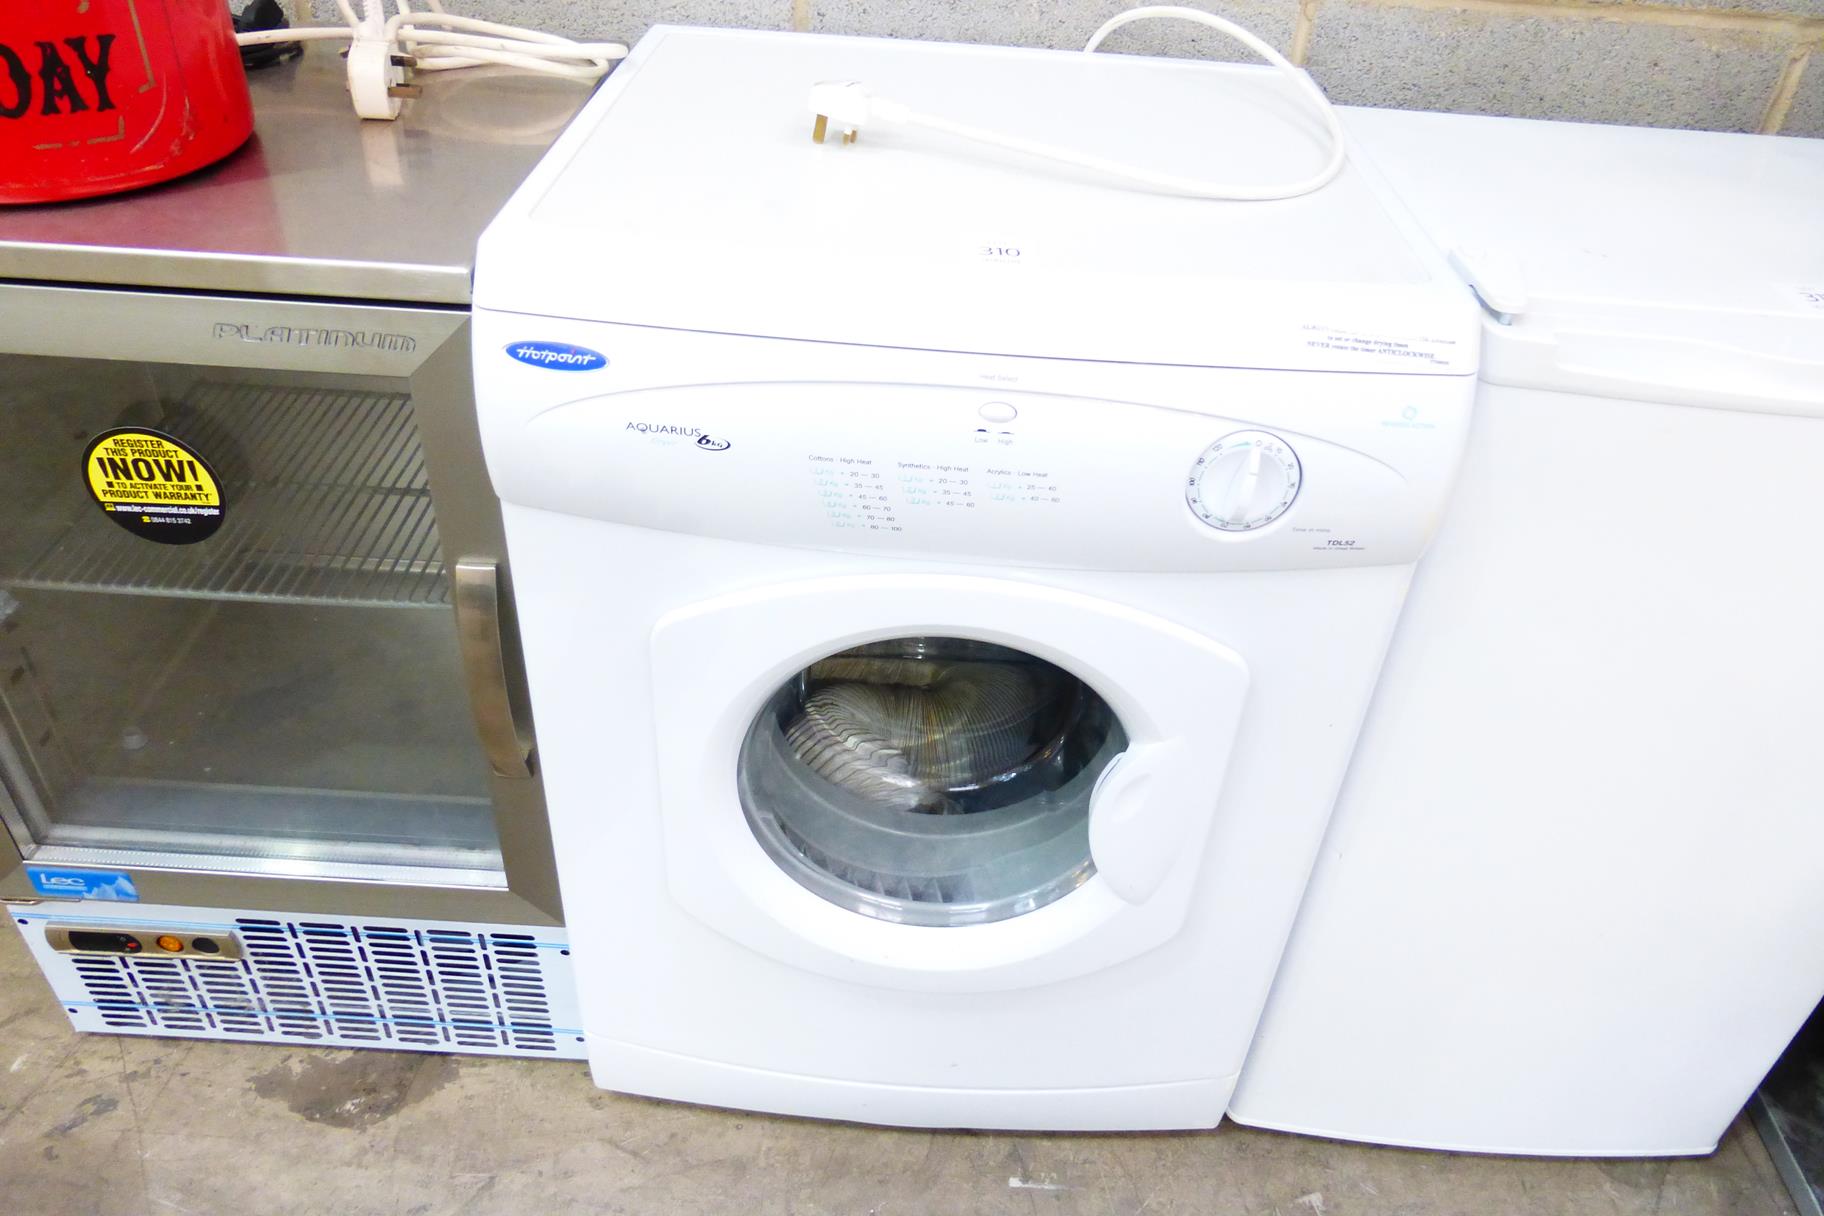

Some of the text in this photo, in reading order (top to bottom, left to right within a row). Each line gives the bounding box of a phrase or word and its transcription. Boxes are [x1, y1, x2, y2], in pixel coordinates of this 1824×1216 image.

[978, 246, 1021, 257] 310
[212, 322, 416, 353] PLATINUM
[516, 345, 597, 366] Hotpoint
[625, 421, 702, 438] AQUARIUS
[112, 438, 164, 449] REGISTER
[104, 447, 180, 459] THIS PRODUCT
[839, 457, 855, 465] High
[117, 482, 194, 492] TO ACTIVATE YOUR
[102, 489, 210, 502] PRODUCT WARRANTY
